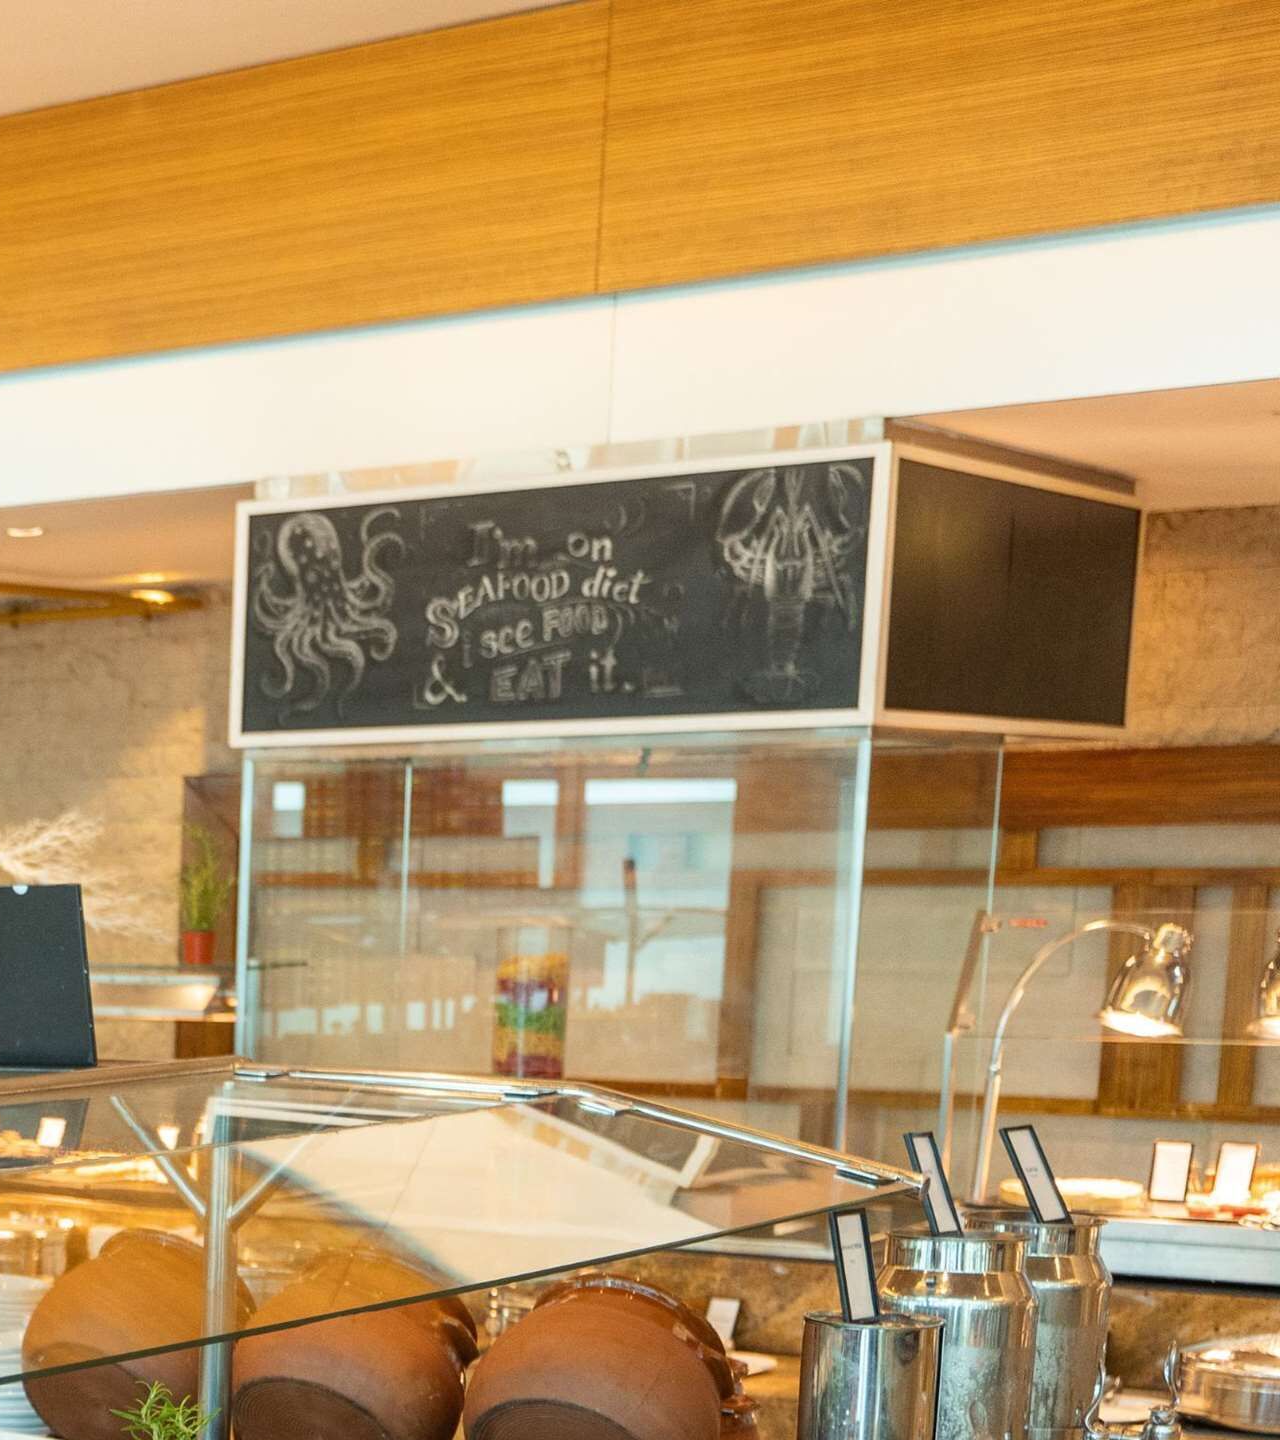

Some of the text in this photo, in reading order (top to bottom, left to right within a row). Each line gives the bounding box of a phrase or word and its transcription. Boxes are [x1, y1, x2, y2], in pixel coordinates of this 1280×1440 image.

[567, 532, 614, 562] on
[425, 565, 652, 649] SEAFOOD diet
[479, 618, 535, 659] see
[542, 604, 609, 642] FOOD
[424, 654, 468, 705] &
[492, 650, 573, 701] EAT
